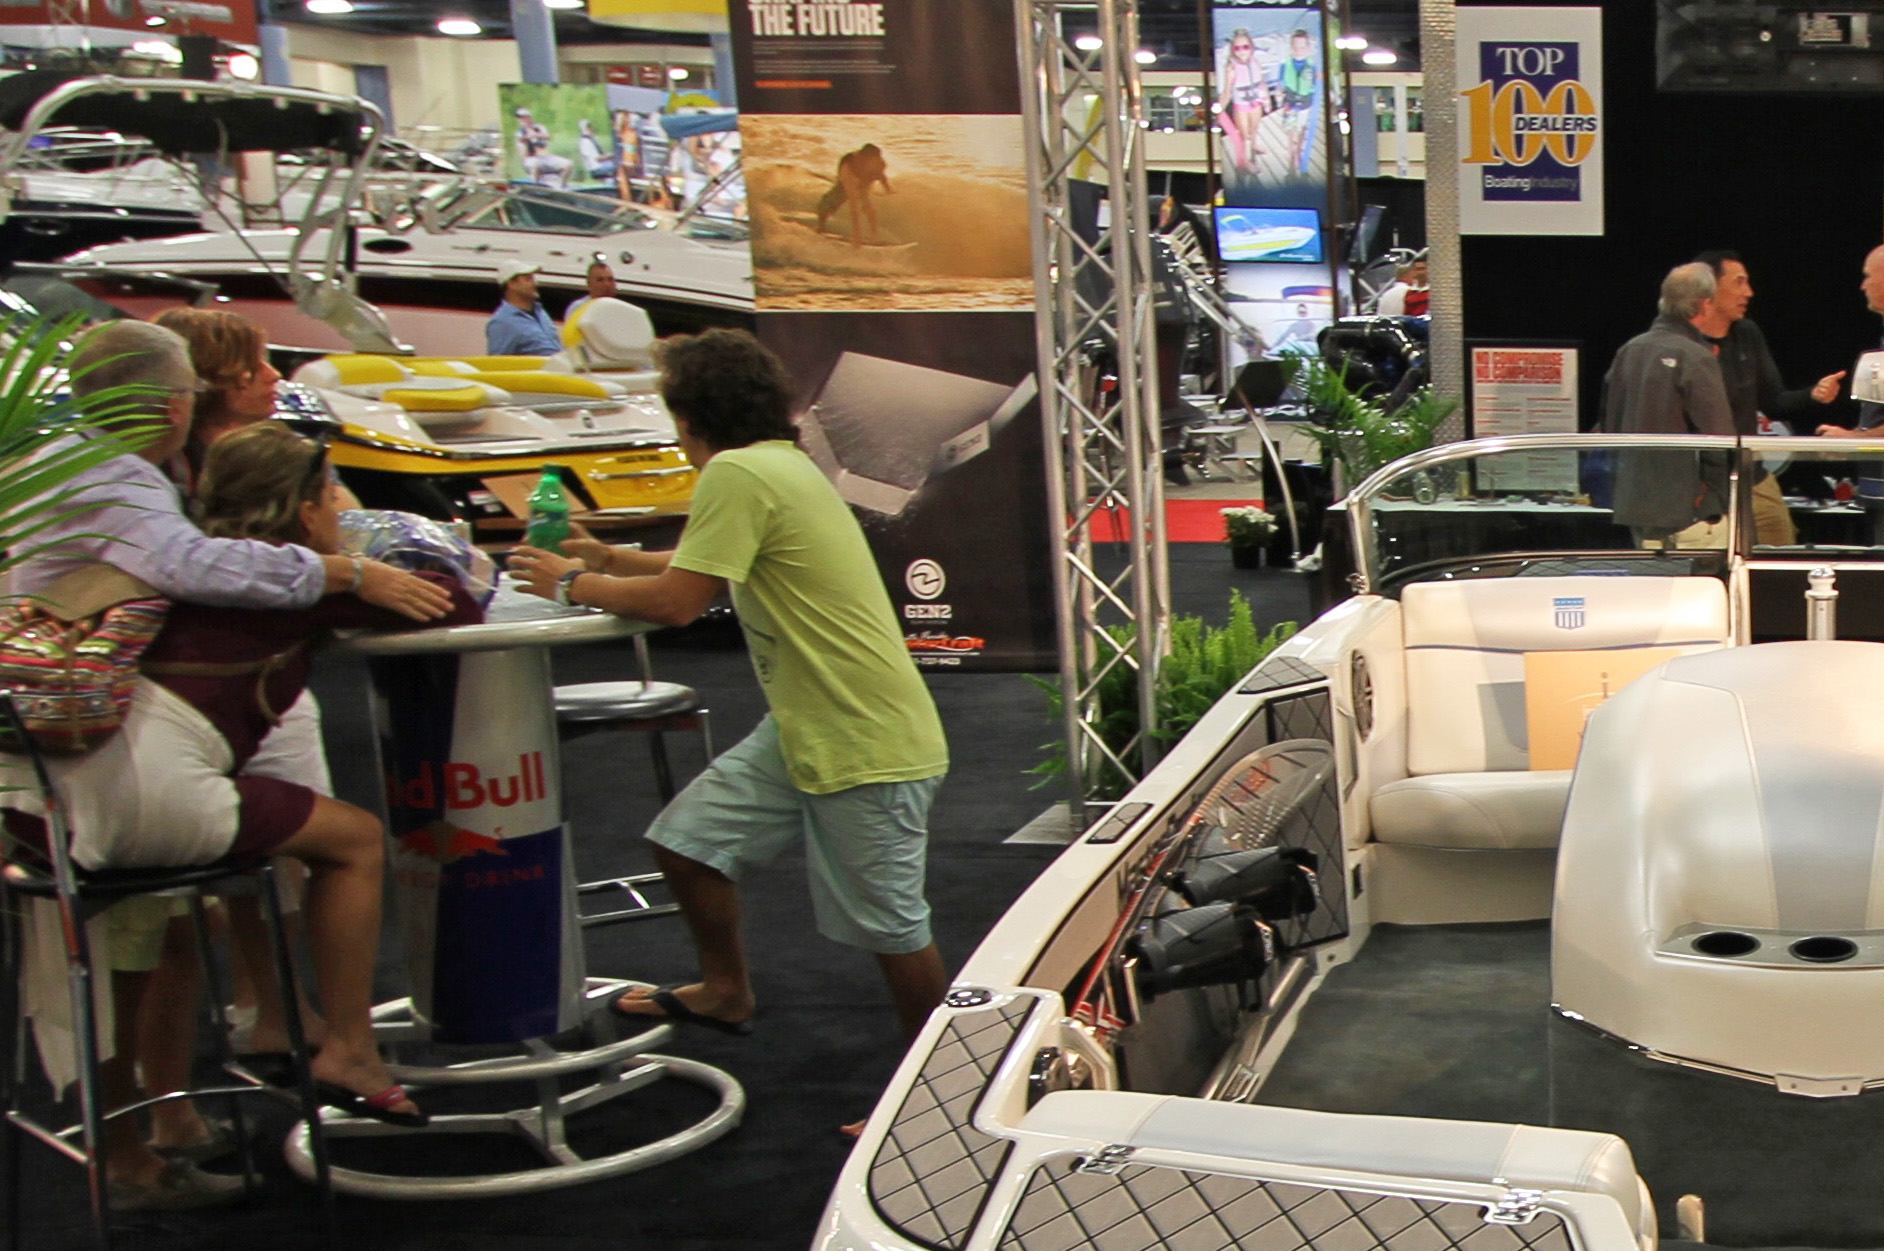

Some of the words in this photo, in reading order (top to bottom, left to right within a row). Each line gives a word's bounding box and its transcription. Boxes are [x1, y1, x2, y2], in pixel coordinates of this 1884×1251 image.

[748, 3, 795, 36] THE
[796, 3, 886, 36] FUTURE
[1495, 47, 1566, 76] TOP
[1459, 78, 1598, 168] 100
[1515, 116, 1598, 132] DEALERS
[443, 751, 546, 810] Bull
